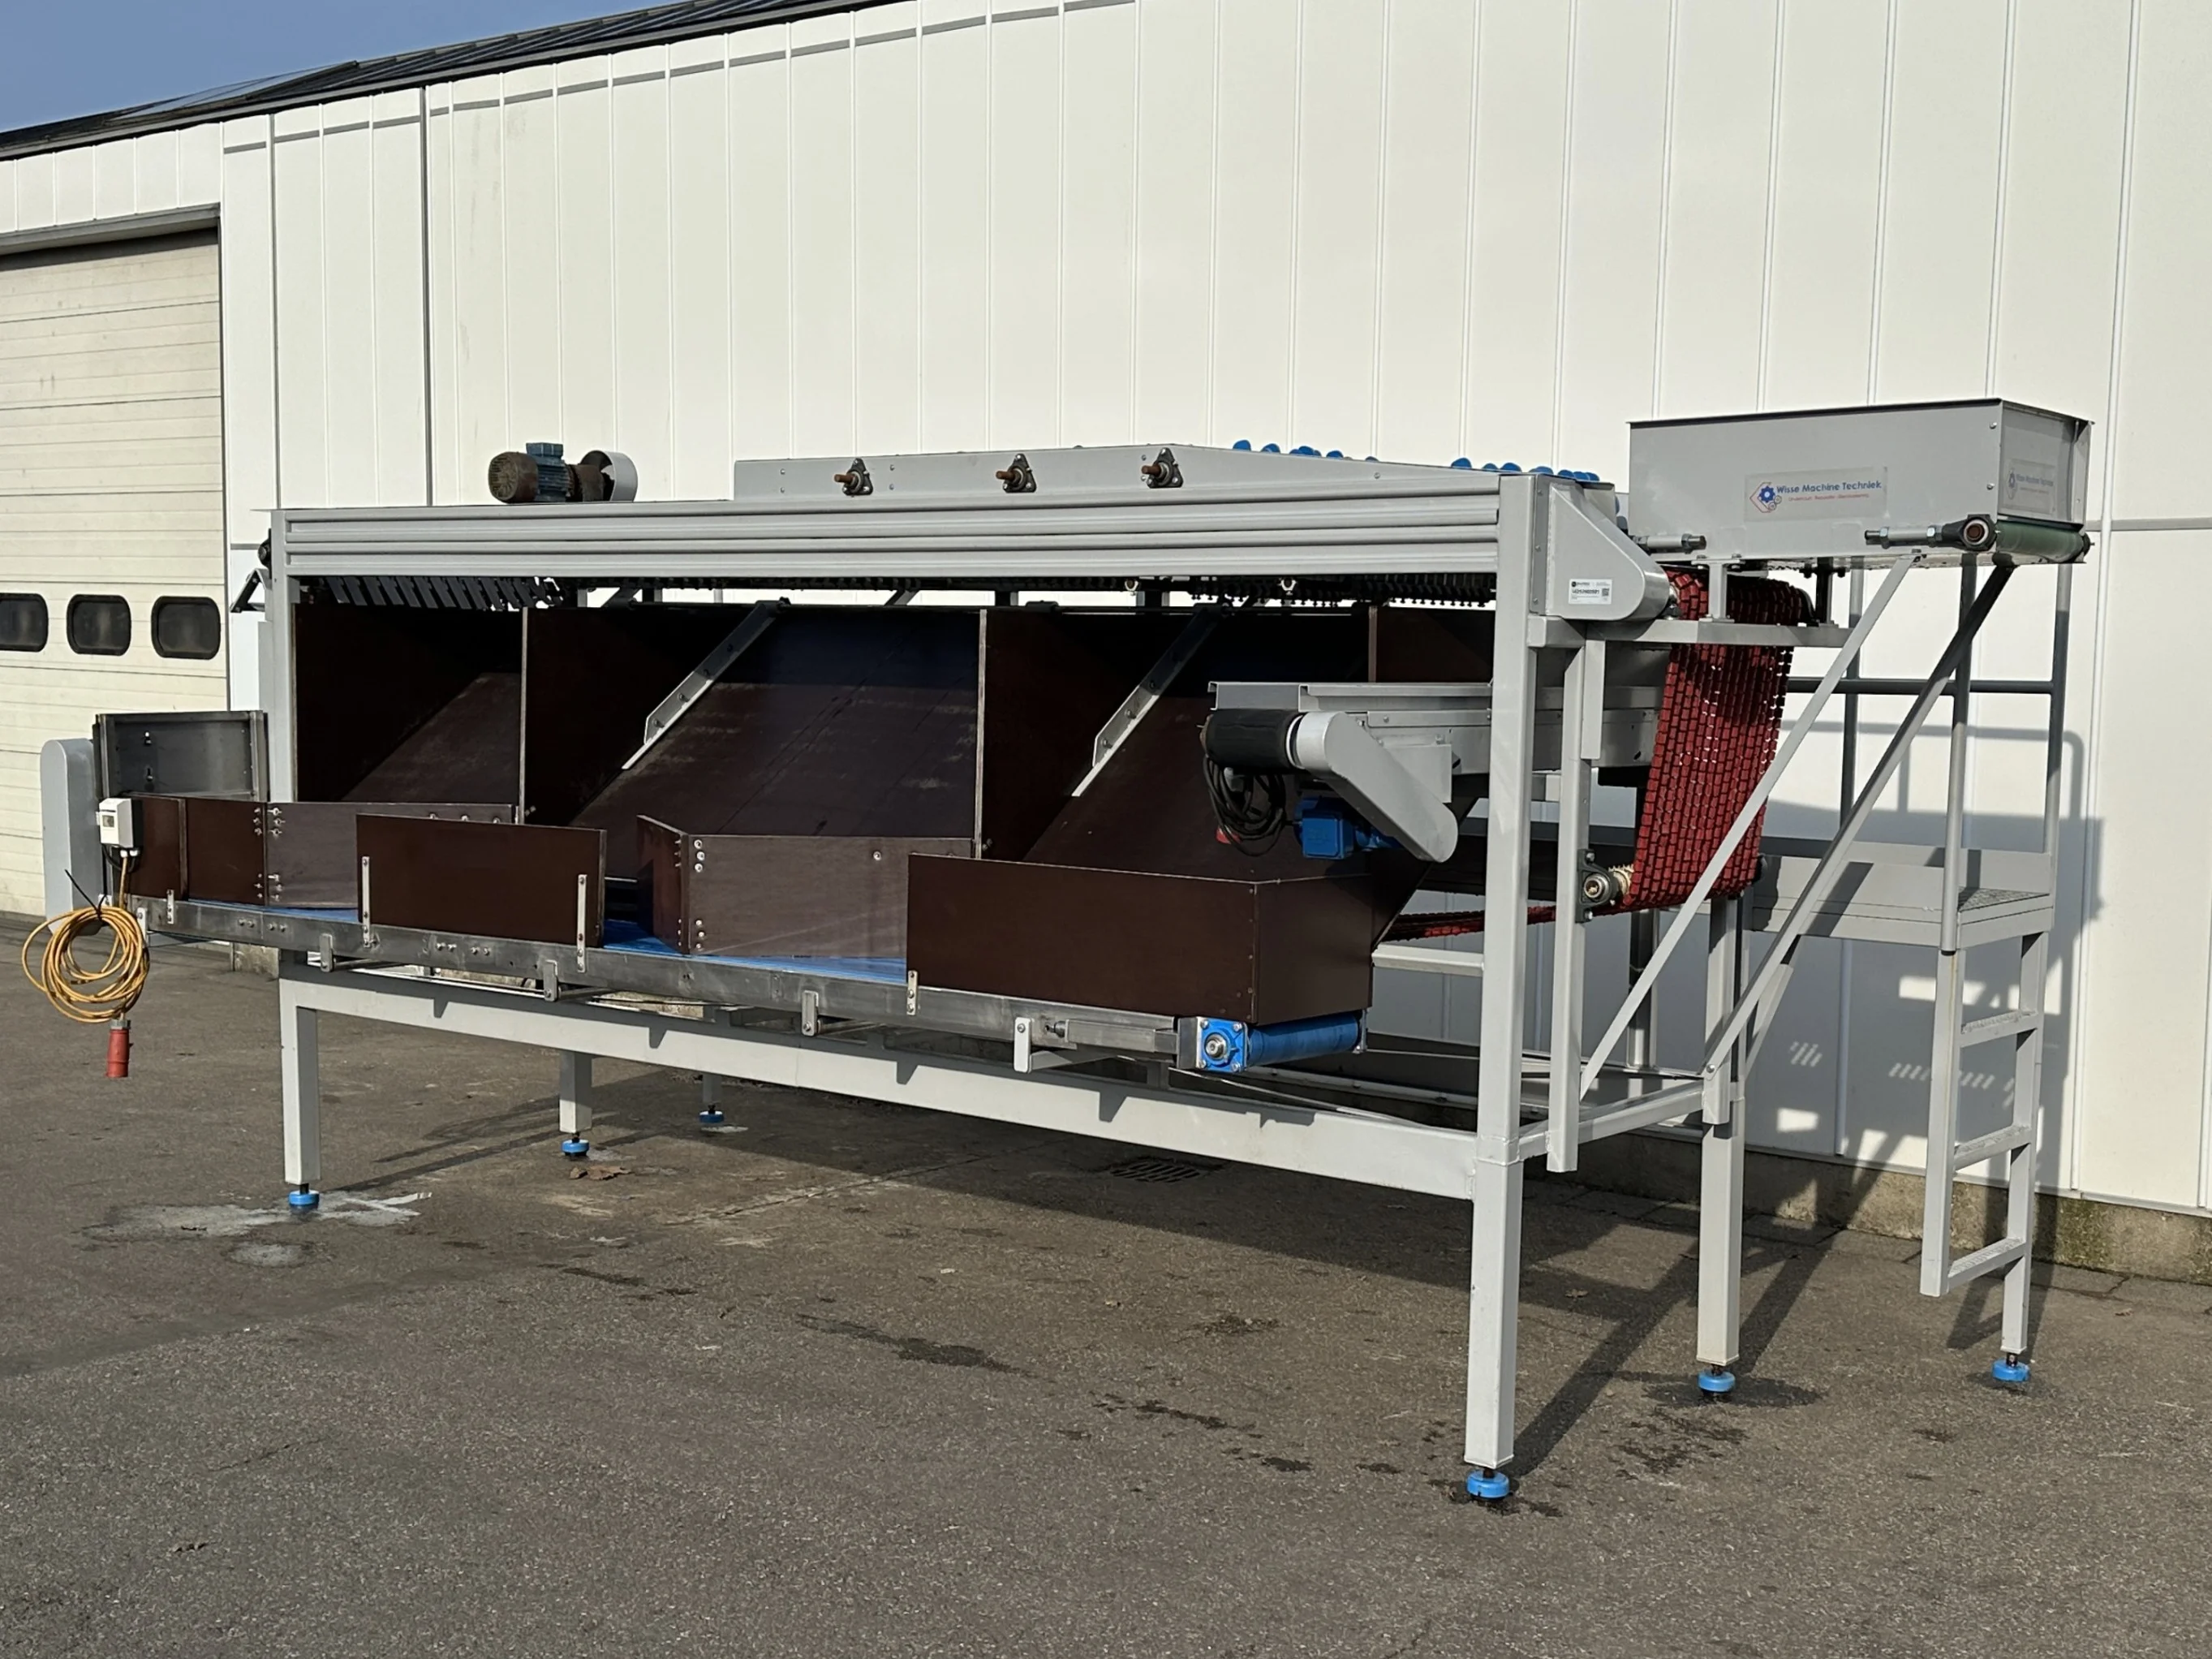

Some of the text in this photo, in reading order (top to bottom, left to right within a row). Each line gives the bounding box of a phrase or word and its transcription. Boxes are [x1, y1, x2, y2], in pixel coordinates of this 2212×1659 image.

[1777, 480, 1882, 493] Wisse Machine Techniek
